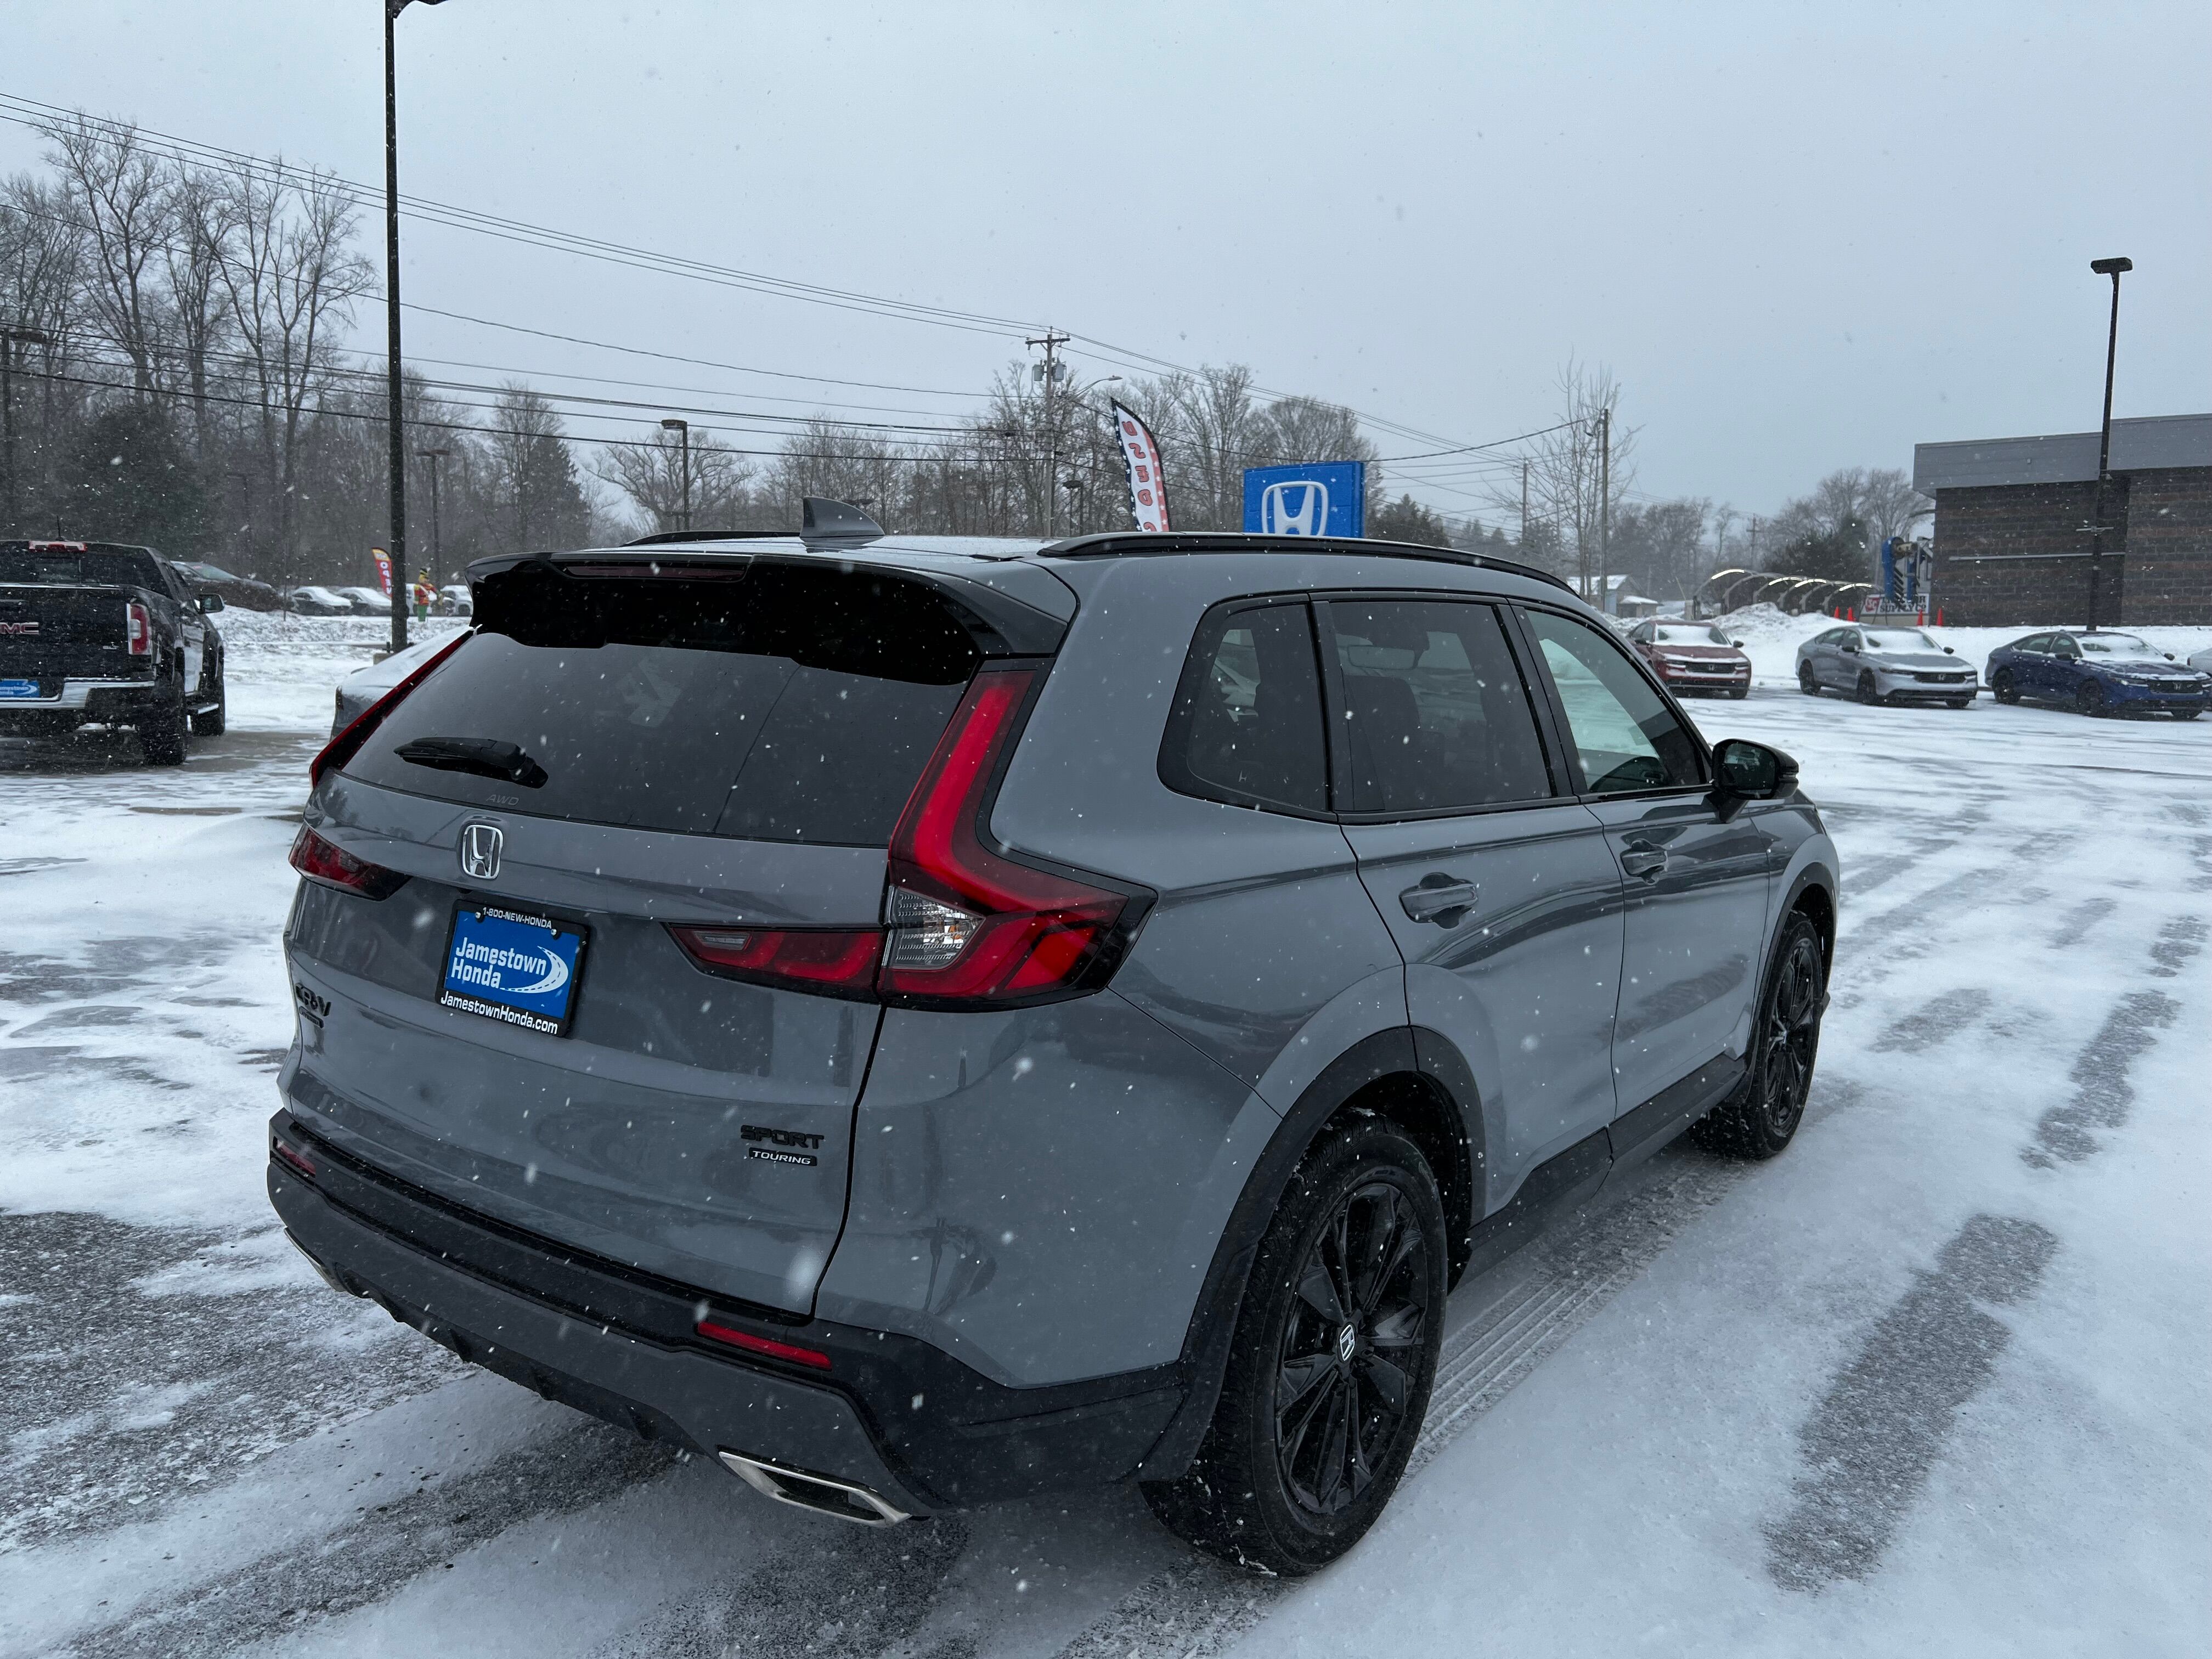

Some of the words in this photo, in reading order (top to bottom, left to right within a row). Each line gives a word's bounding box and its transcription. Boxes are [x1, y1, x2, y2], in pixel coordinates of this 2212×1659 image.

[0, 622, 39, 635] MC
[486, 794, 519, 806] AWD
[483, 907, 552, 929] 1-800-NEW-HONDA
[456, 937, 547, 976] Jamestown
[451, 957, 501, 989] Honda
[441, 991, 558, 1035] JamestownHonda.com
[741, 1125, 825, 1149] SPORT
[753, 1150, 811, 1165] TOURING
